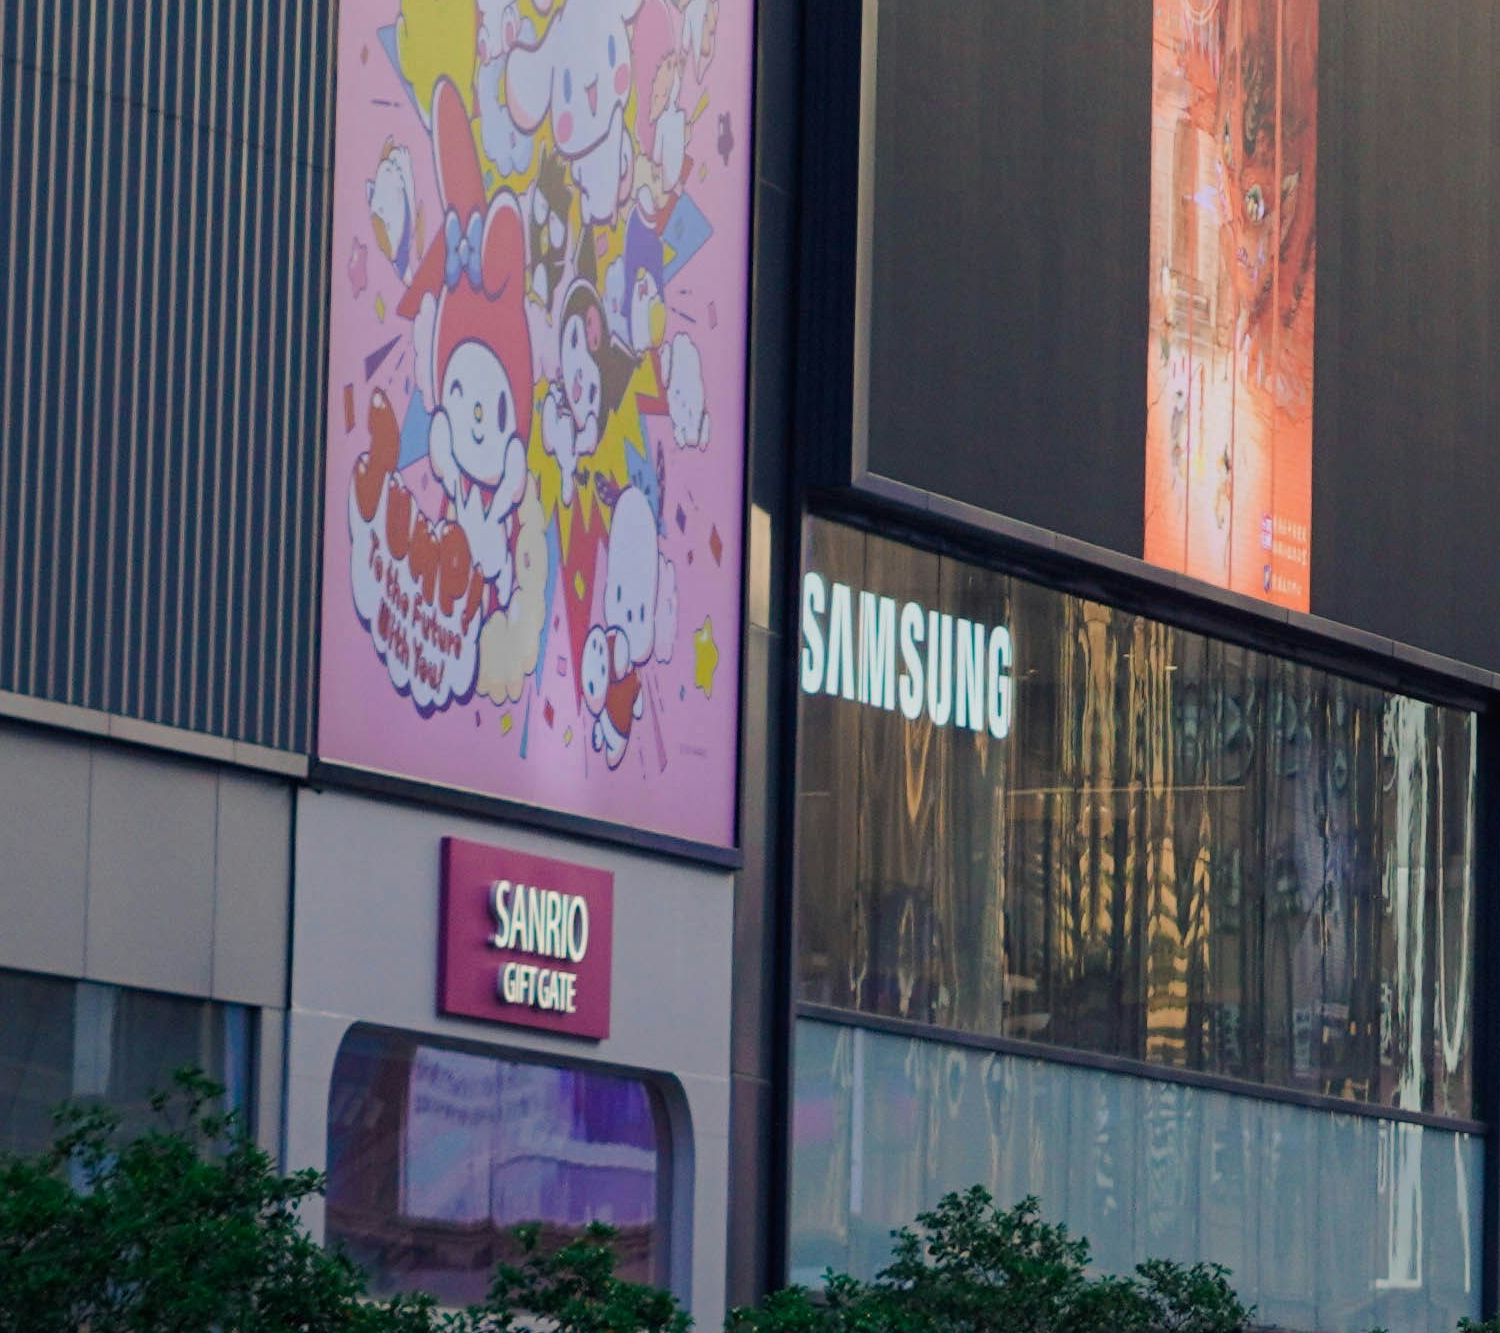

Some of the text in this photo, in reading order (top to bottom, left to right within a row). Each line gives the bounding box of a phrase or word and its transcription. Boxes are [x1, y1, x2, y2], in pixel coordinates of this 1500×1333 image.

[801, 571, 1013, 740] SAMSUNG
[494, 880, 588, 963] SANRIO
[503, 962, 577, 1013] GIFT GATE
